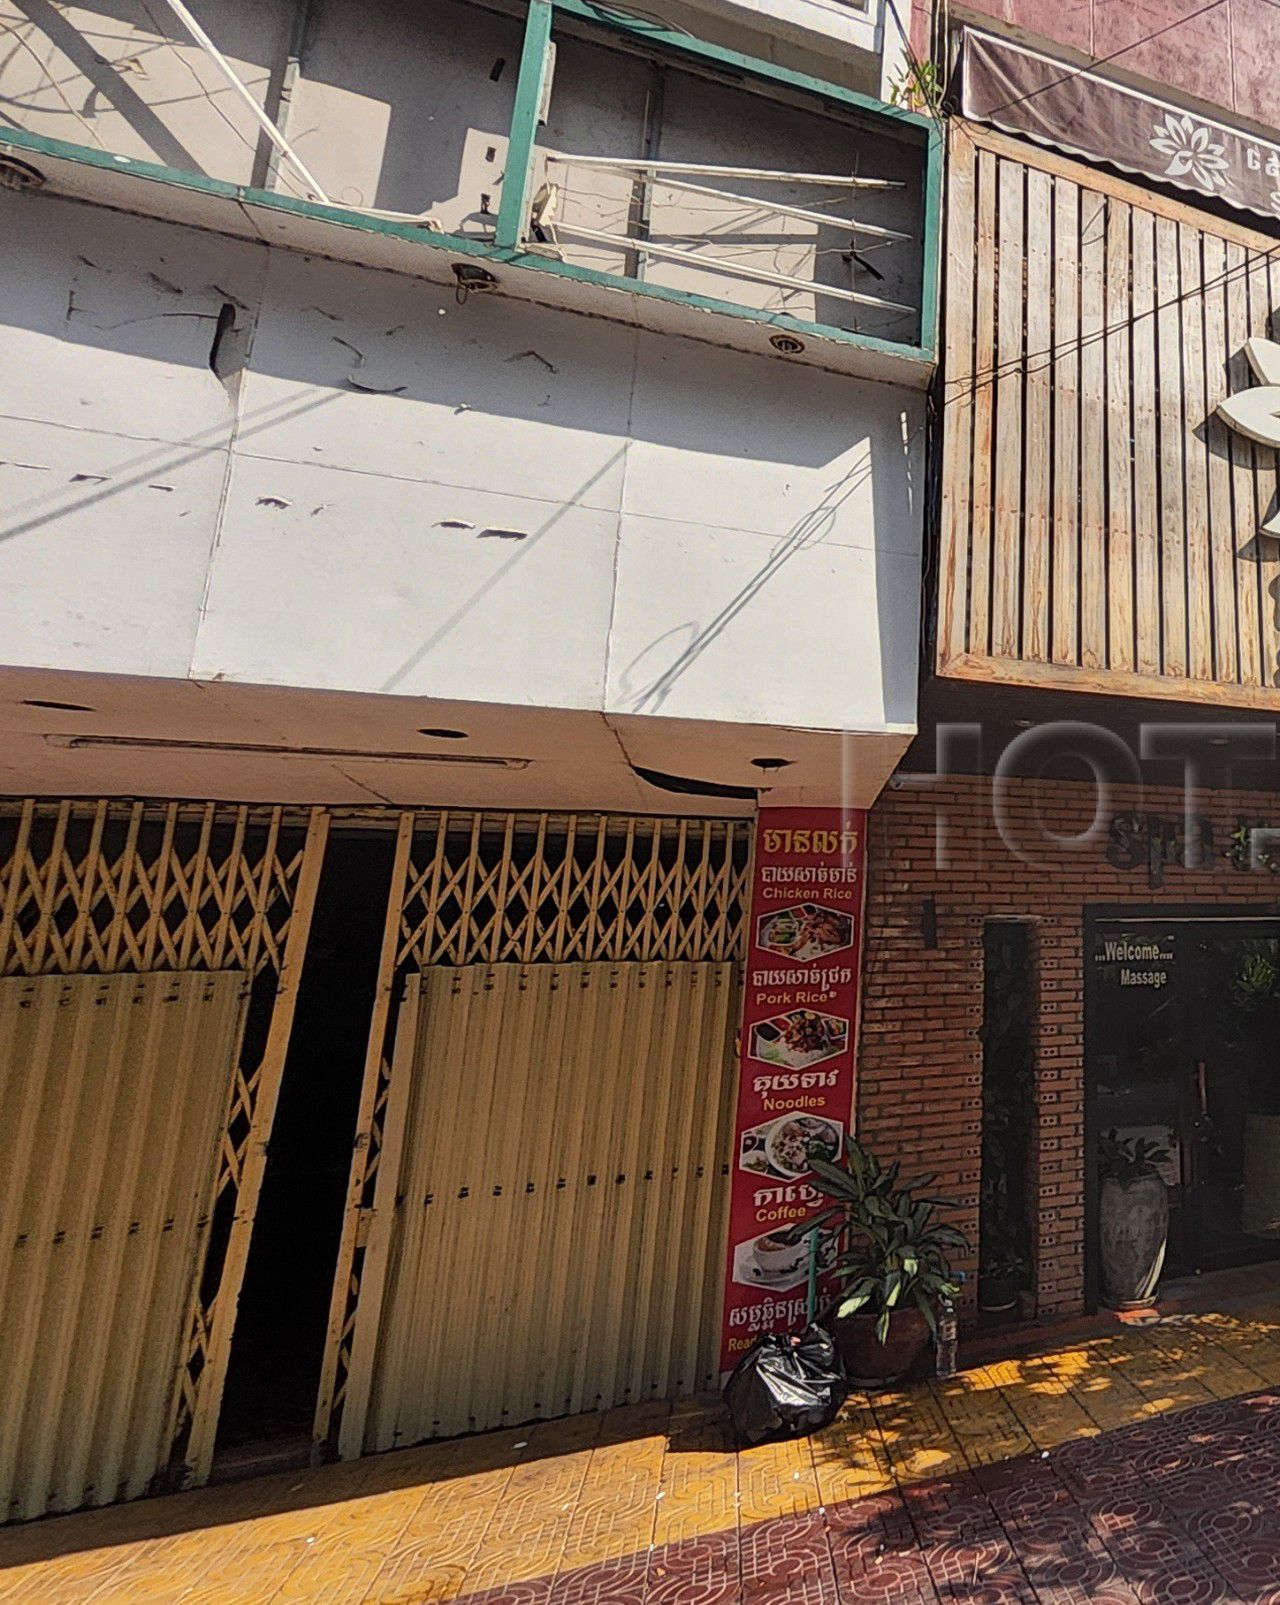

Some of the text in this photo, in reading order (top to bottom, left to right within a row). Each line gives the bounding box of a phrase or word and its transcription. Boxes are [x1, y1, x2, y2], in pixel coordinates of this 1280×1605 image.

[763, 821, 858, 854] មានលក់
[762, 887, 853, 899] Chicken Rice
[1120, 968, 1167, 988] Massage
[756, 991, 828, 1005] Pork Rice
[753, 1069, 840, 1099] គុយទាវ
[763, 1095, 826, 1111] Noodles
[756, 1206, 806, 1222] Coffee
